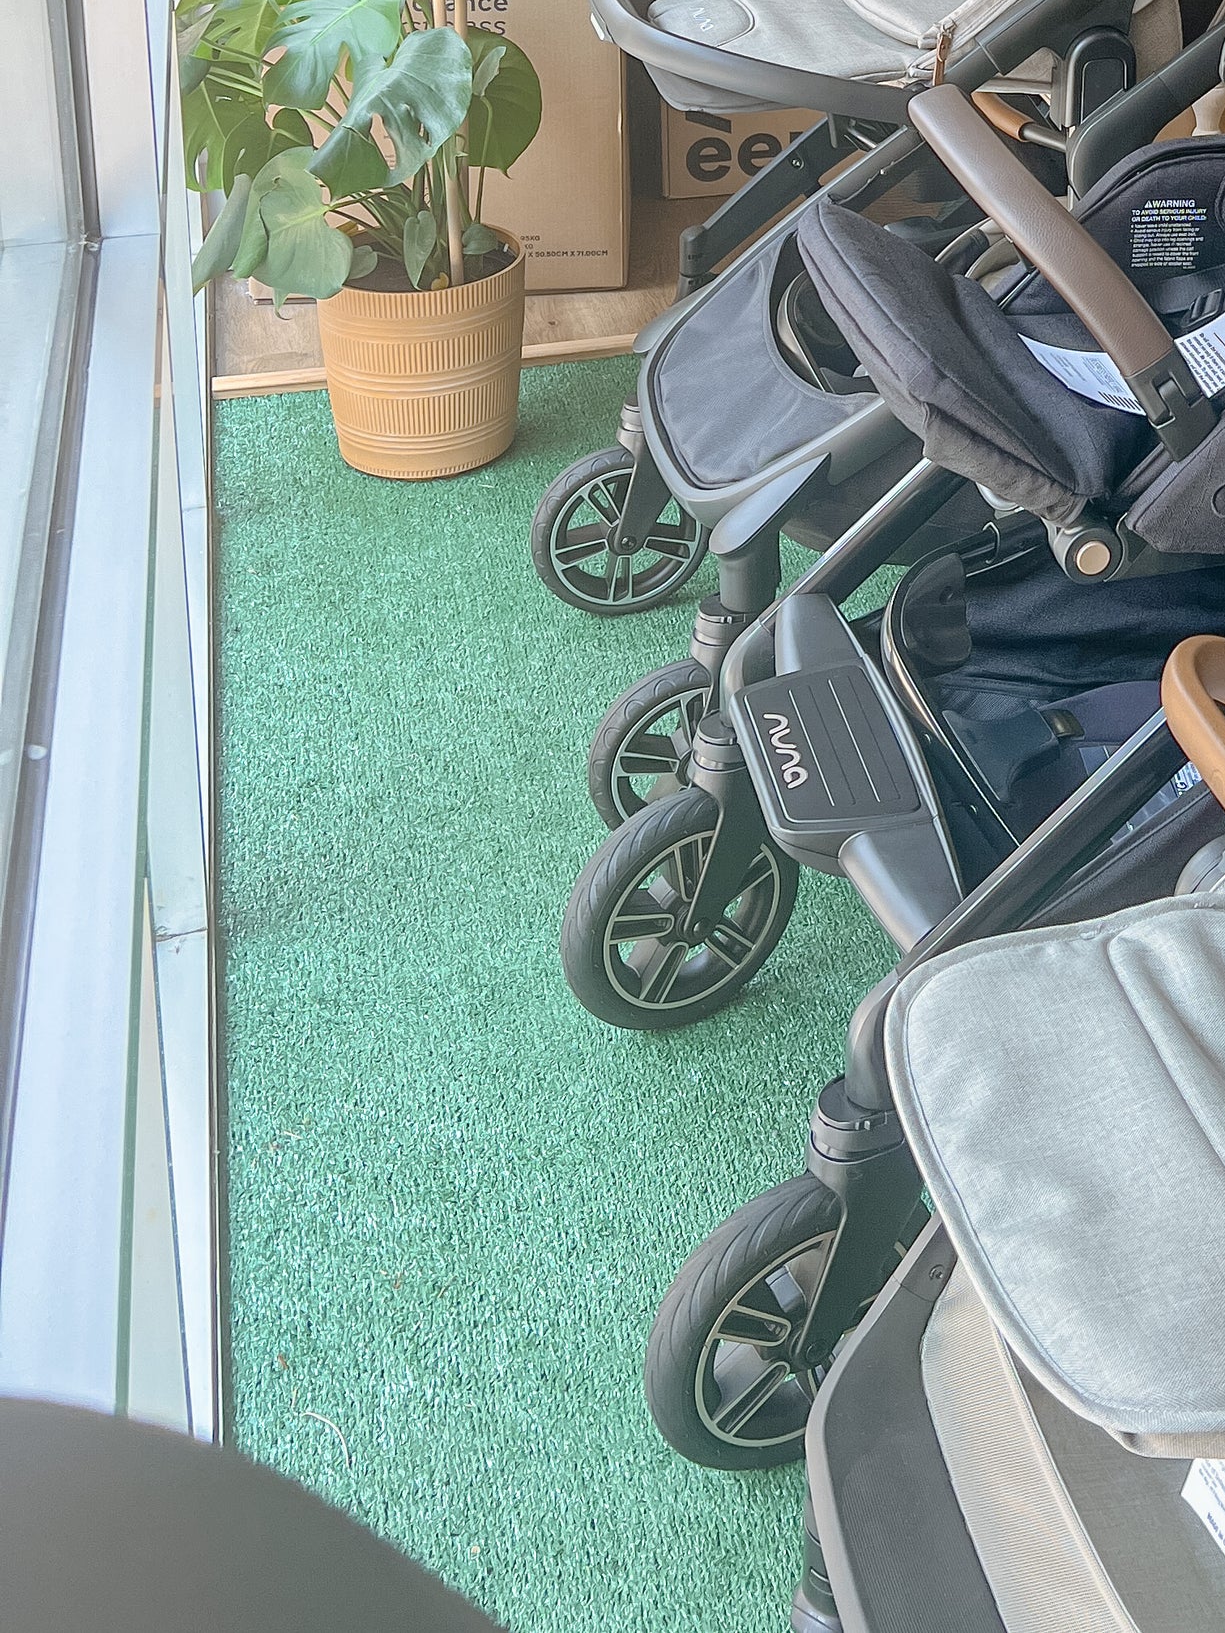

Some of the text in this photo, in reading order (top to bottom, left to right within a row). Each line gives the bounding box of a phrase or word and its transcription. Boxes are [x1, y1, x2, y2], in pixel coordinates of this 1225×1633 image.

[1152, 199, 1196, 208] WARNING
[535, 250, 569, 258] 50.50CM
[577, 249, 608, 257] 71.00CM
[761, 712, 809, 790] nuna
